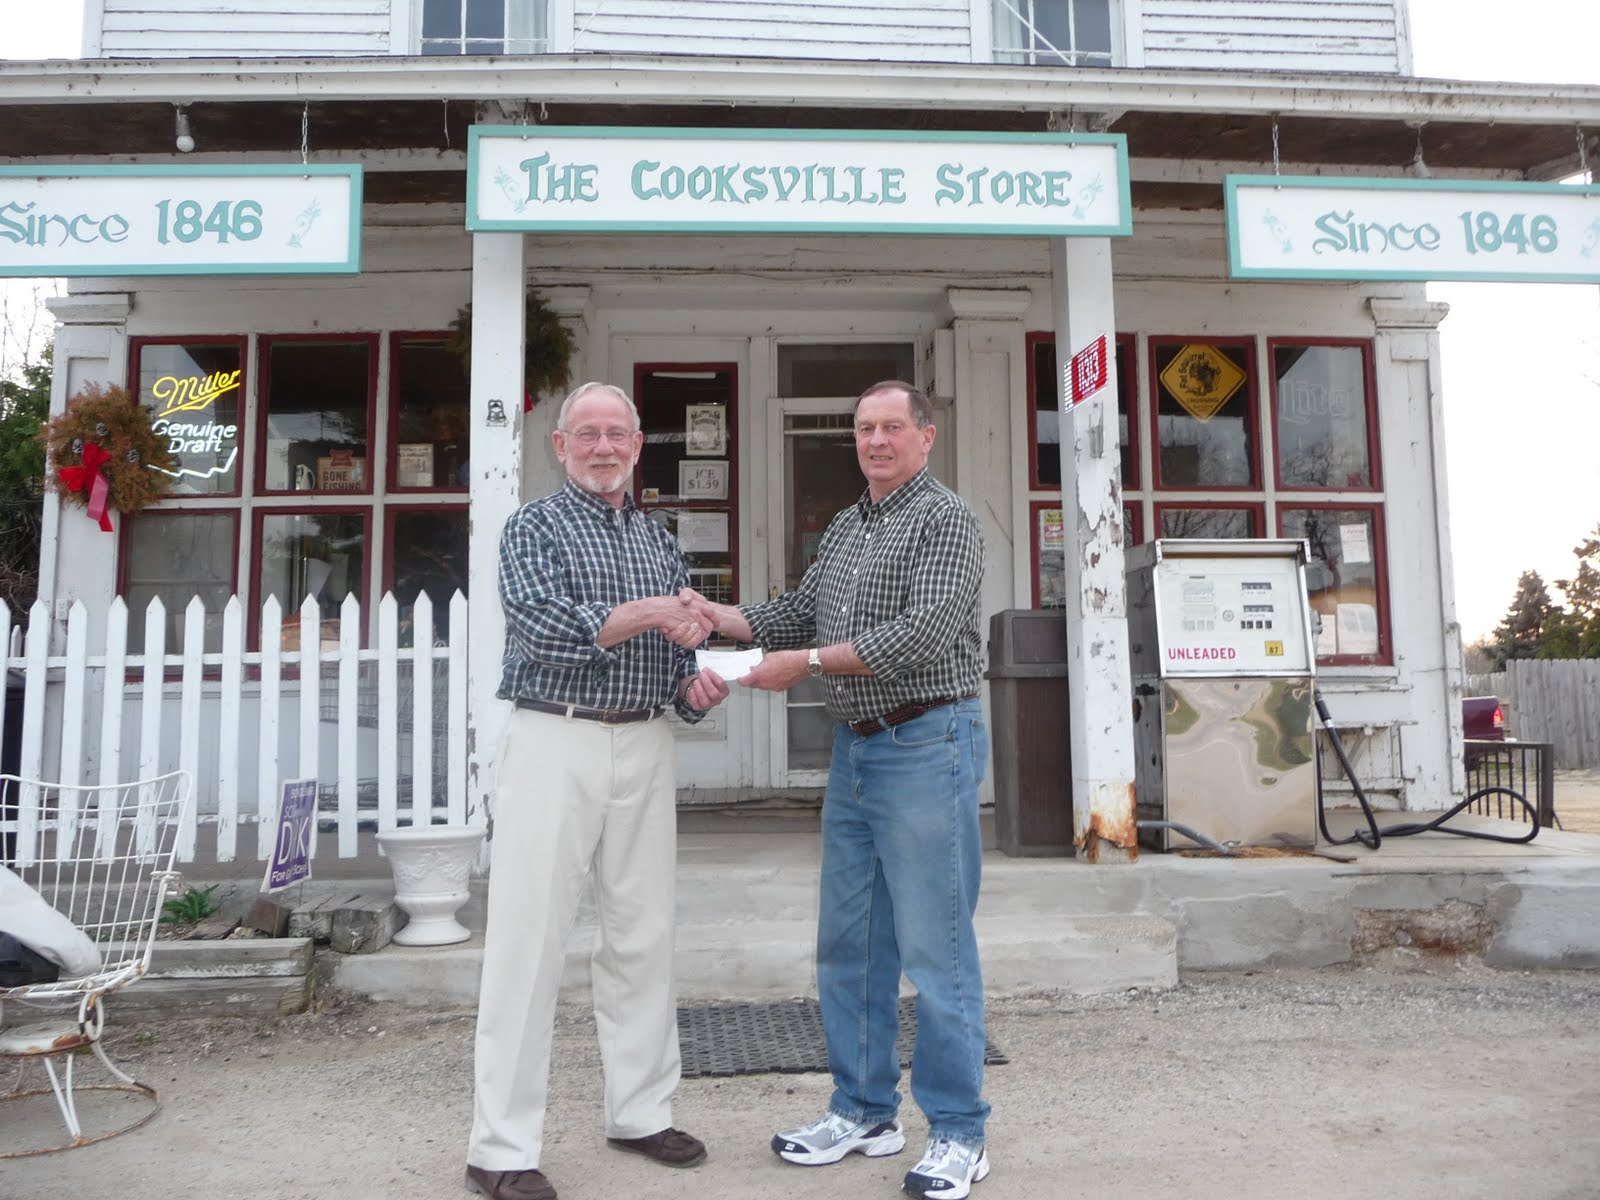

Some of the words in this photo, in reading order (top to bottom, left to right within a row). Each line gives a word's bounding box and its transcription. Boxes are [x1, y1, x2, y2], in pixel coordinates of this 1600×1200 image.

[519, 151, 599, 205] THE
[631, 160, 907, 206] COOKSVILLE
[935, 162, 1073, 208] STORE
[0, 200, 130, 247] Since
[155, 198, 263, 246] 1846
[1312, 209, 1441, 255] Since
[1458, 211, 1558, 256] 1846
[152, 369, 241, 410] Miller
[152, 419, 237, 438] Genuine
[167, 437, 222, 454] Draft
[323, 470, 348, 482] GONE
[695, 468, 716, 479] ICE
[688, 479, 719, 490] $1.59
[1168, 647, 1236, 660] UNLEADED
